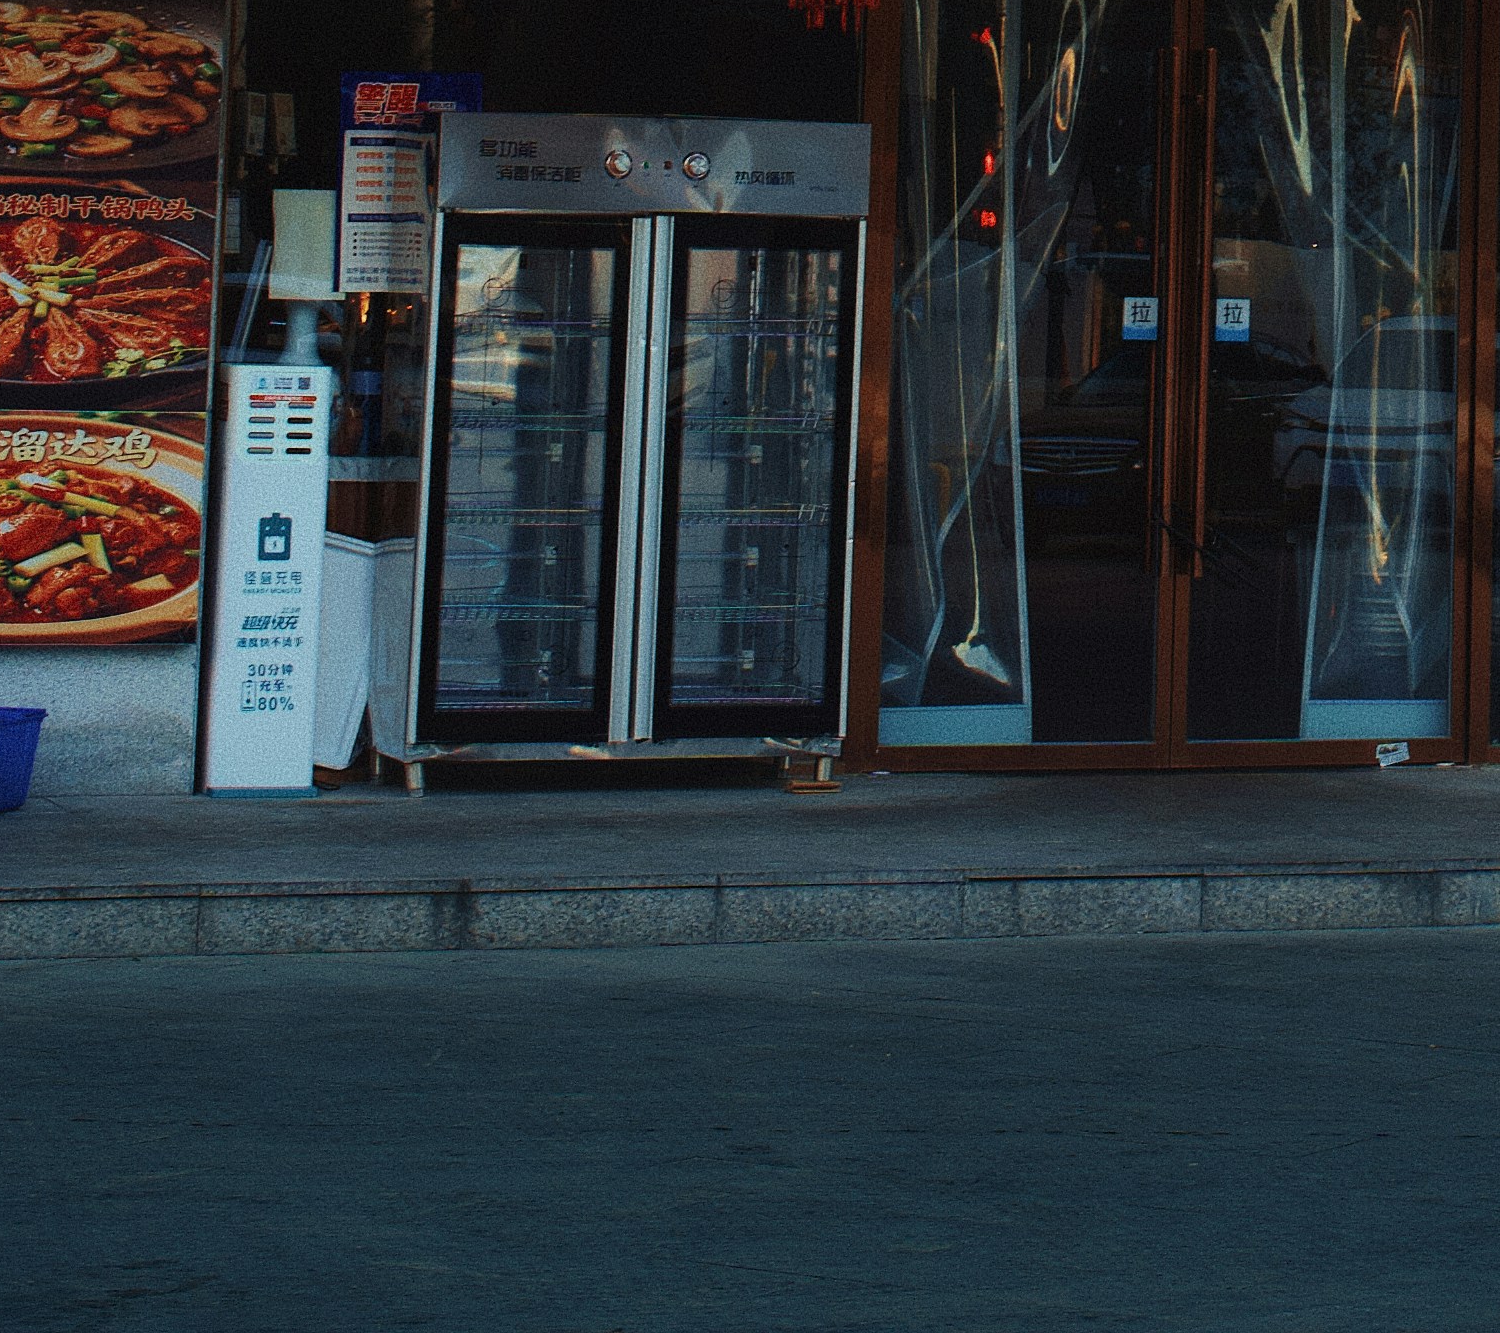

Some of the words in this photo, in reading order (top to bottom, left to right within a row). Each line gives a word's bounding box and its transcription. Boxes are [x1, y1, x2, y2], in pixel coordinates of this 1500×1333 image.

[479, 139, 538, 159] 多功能
[495, 164, 582, 183] 消毒保洁柜
[734, 170, 796, 186] 热风循环
[1131, 301, 1151, 324] 拉
[1223, 302, 1243, 325] 拉
[244, 571, 303, 586] 怪兽充电
[241, 614, 300, 631] 超级快充
[248, 663, 293, 677] 30分钟
[257, 696, 294, 712] 80%
